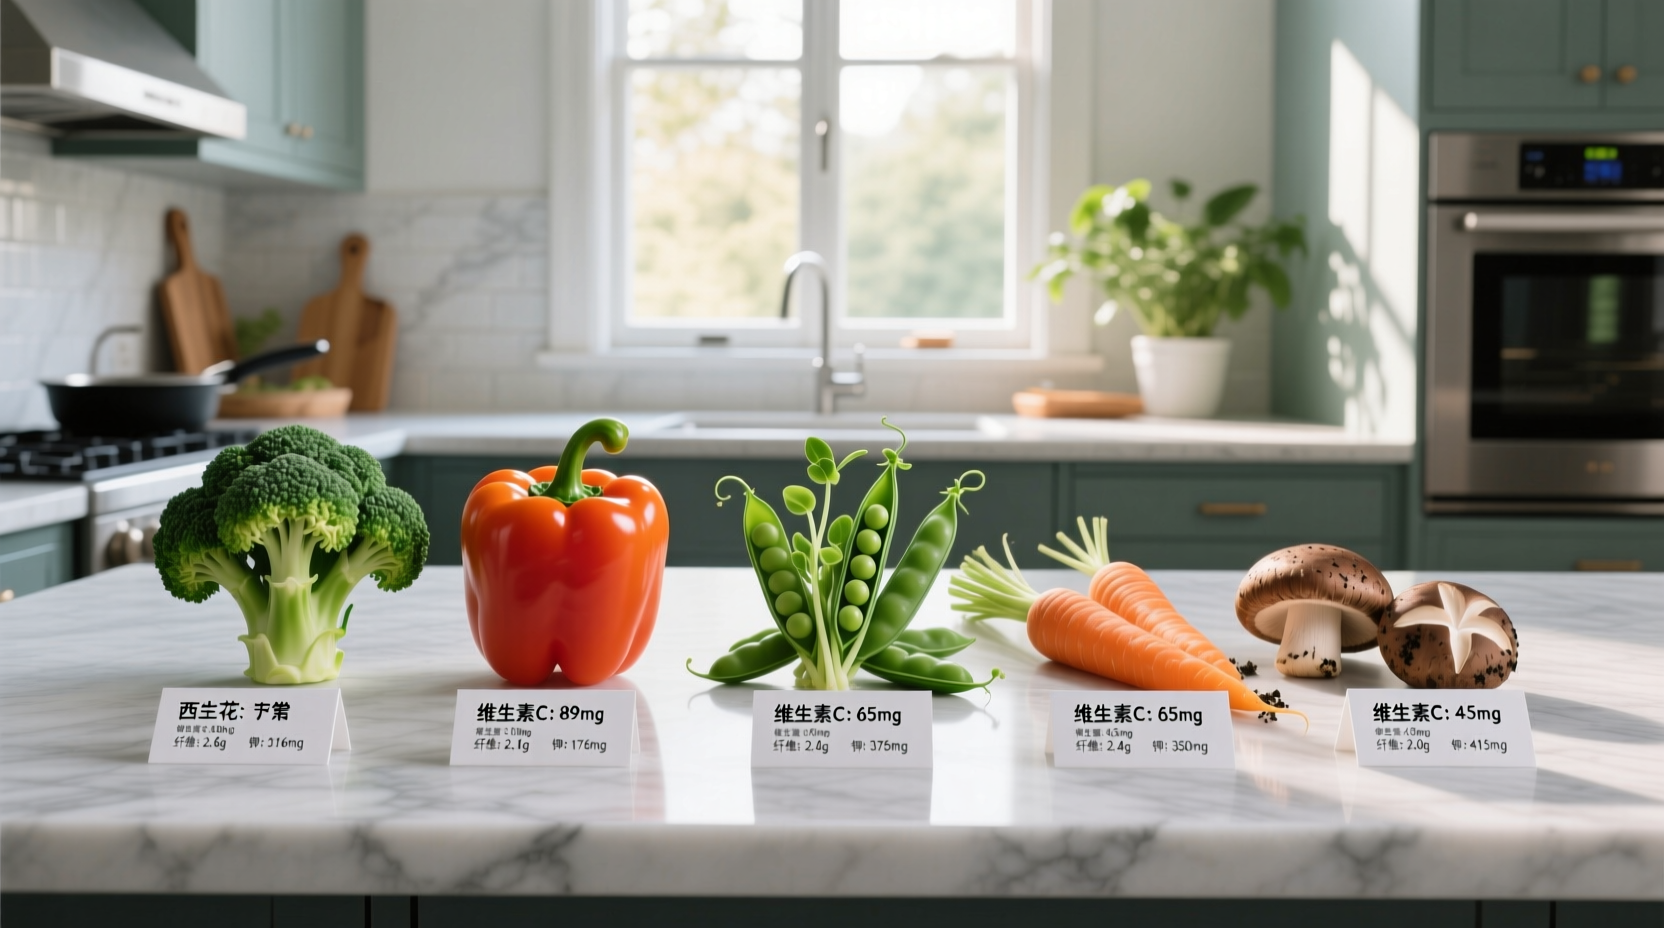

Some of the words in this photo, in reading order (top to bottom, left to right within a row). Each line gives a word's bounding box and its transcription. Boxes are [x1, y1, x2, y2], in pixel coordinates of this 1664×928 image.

[477, 703, 554, 723] 维生素C:
[560, 705, 604, 725] 89mg
[774, 704, 851, 724] 维生素C:
[857, 707, 901, 726] 65mg
[1074, 703, 1152, 724] 维生素C:
[1158, 707, 1202, 726] 65mg
[1373, 703, 1449, 723] 维生素C:
[1455, 705, 1501, 724] 45mg
[203, 736, 226, 751] 2.6g
[504, 739, 529, 753] 2.1g
[572, 739, 606, 753] 176mg
[1407, 739, 1429, 753] 2.0g
[1470, 739, 1507, 754] 415mg
